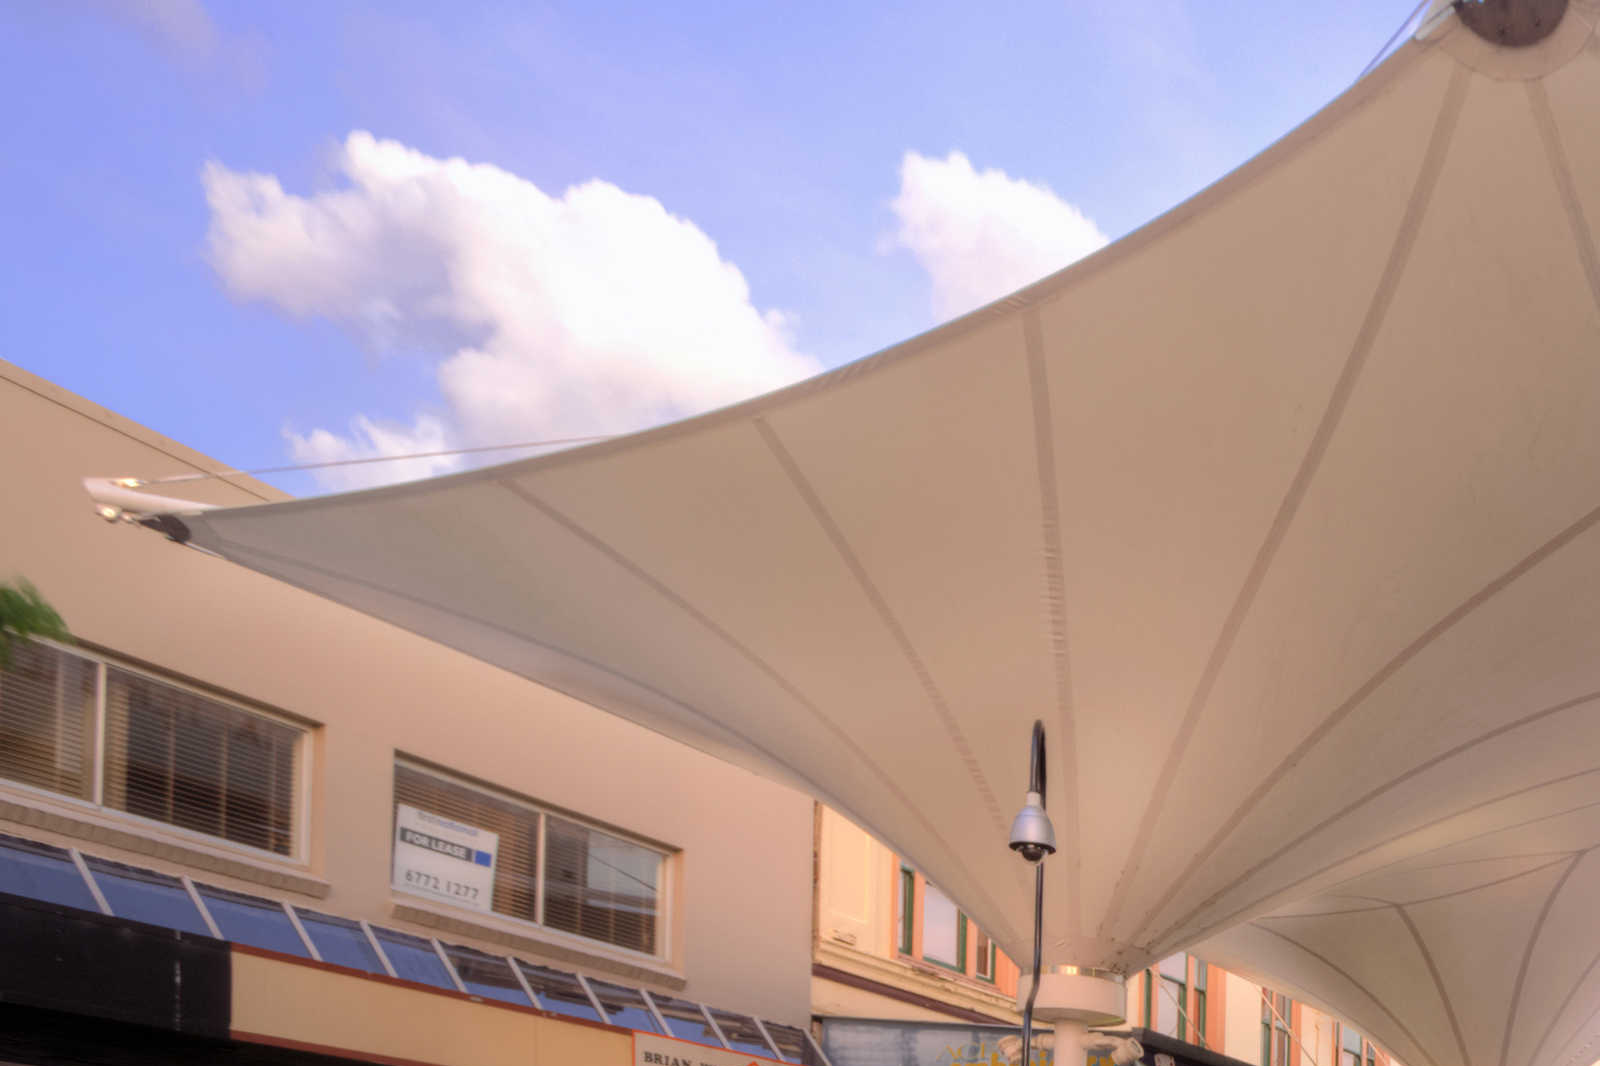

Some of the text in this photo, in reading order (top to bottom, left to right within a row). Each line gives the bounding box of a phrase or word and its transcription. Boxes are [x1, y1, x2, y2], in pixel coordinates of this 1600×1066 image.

[406, 832, 466, 860] FOR LEASE
[406, 870, 440, 890] 6772
